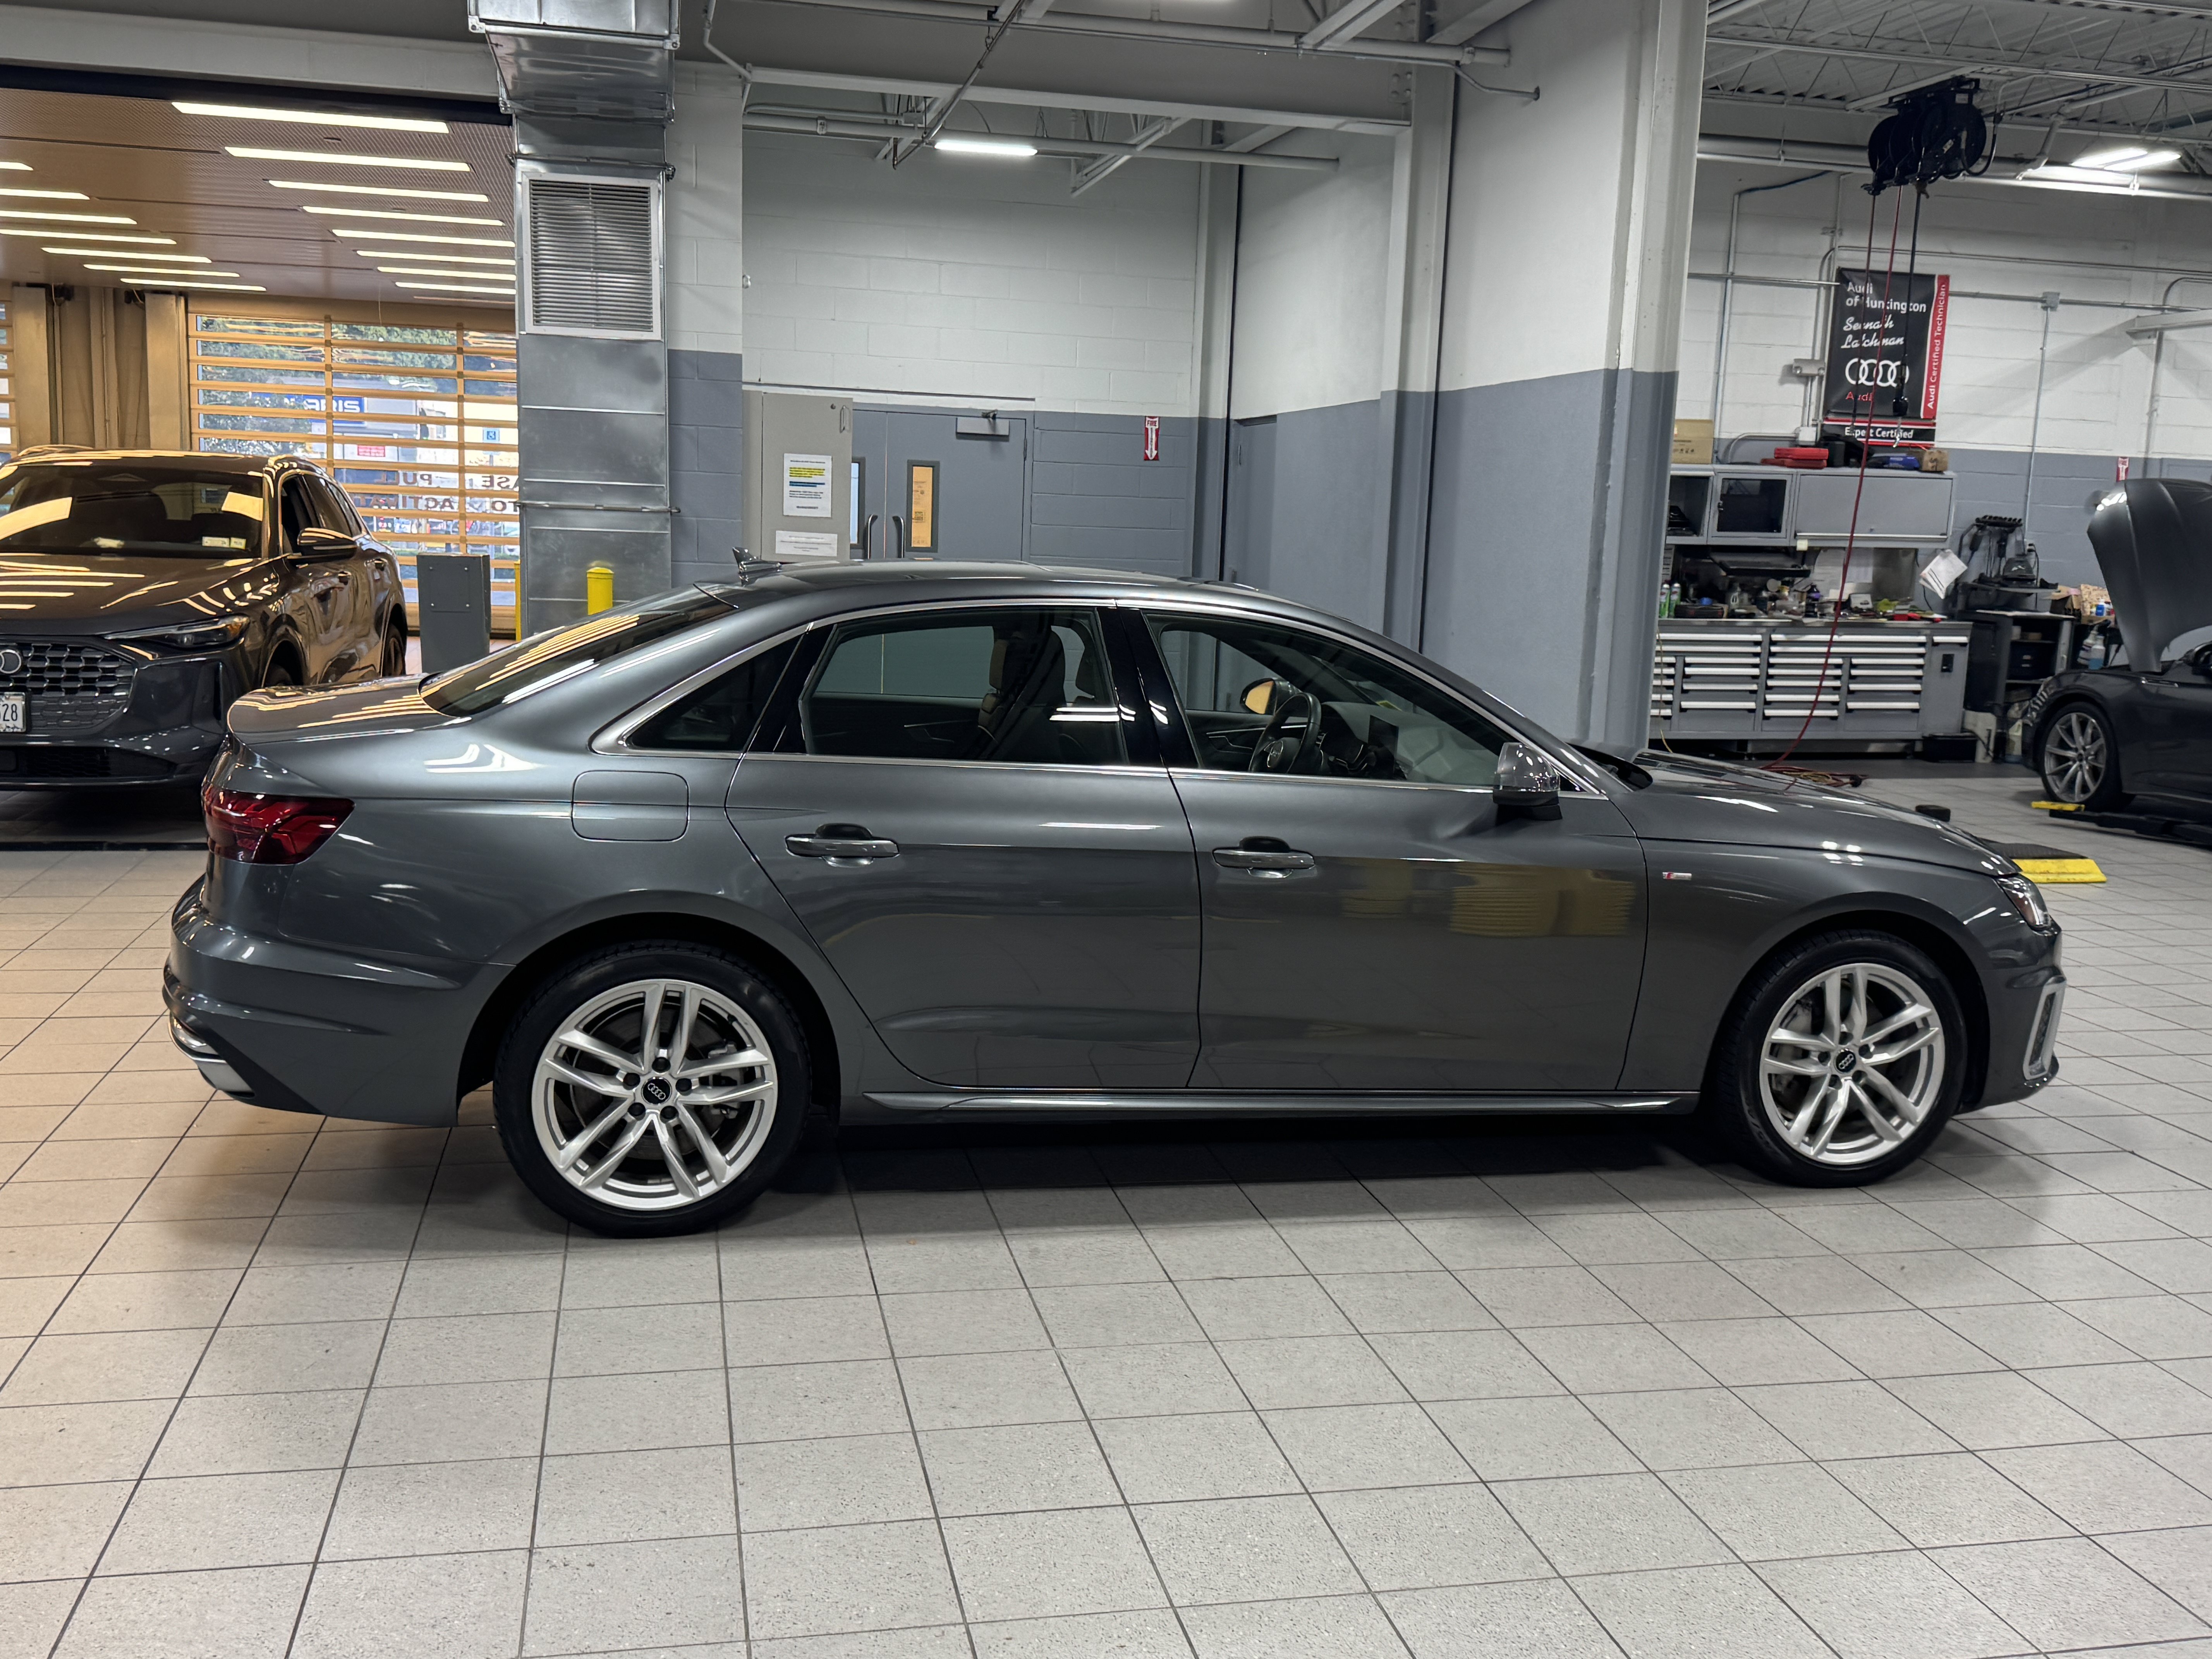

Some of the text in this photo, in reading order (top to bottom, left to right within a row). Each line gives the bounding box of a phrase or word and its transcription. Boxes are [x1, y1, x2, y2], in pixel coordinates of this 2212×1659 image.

[1847, 282, 1873, 294] Audi
[1846, 295, 1860, 306] of
[1927, 285, 1946, 409] Audi Certified Technician
[1845, 427, 1874, 438] Epet
[0, 703, 18, 721] 28
